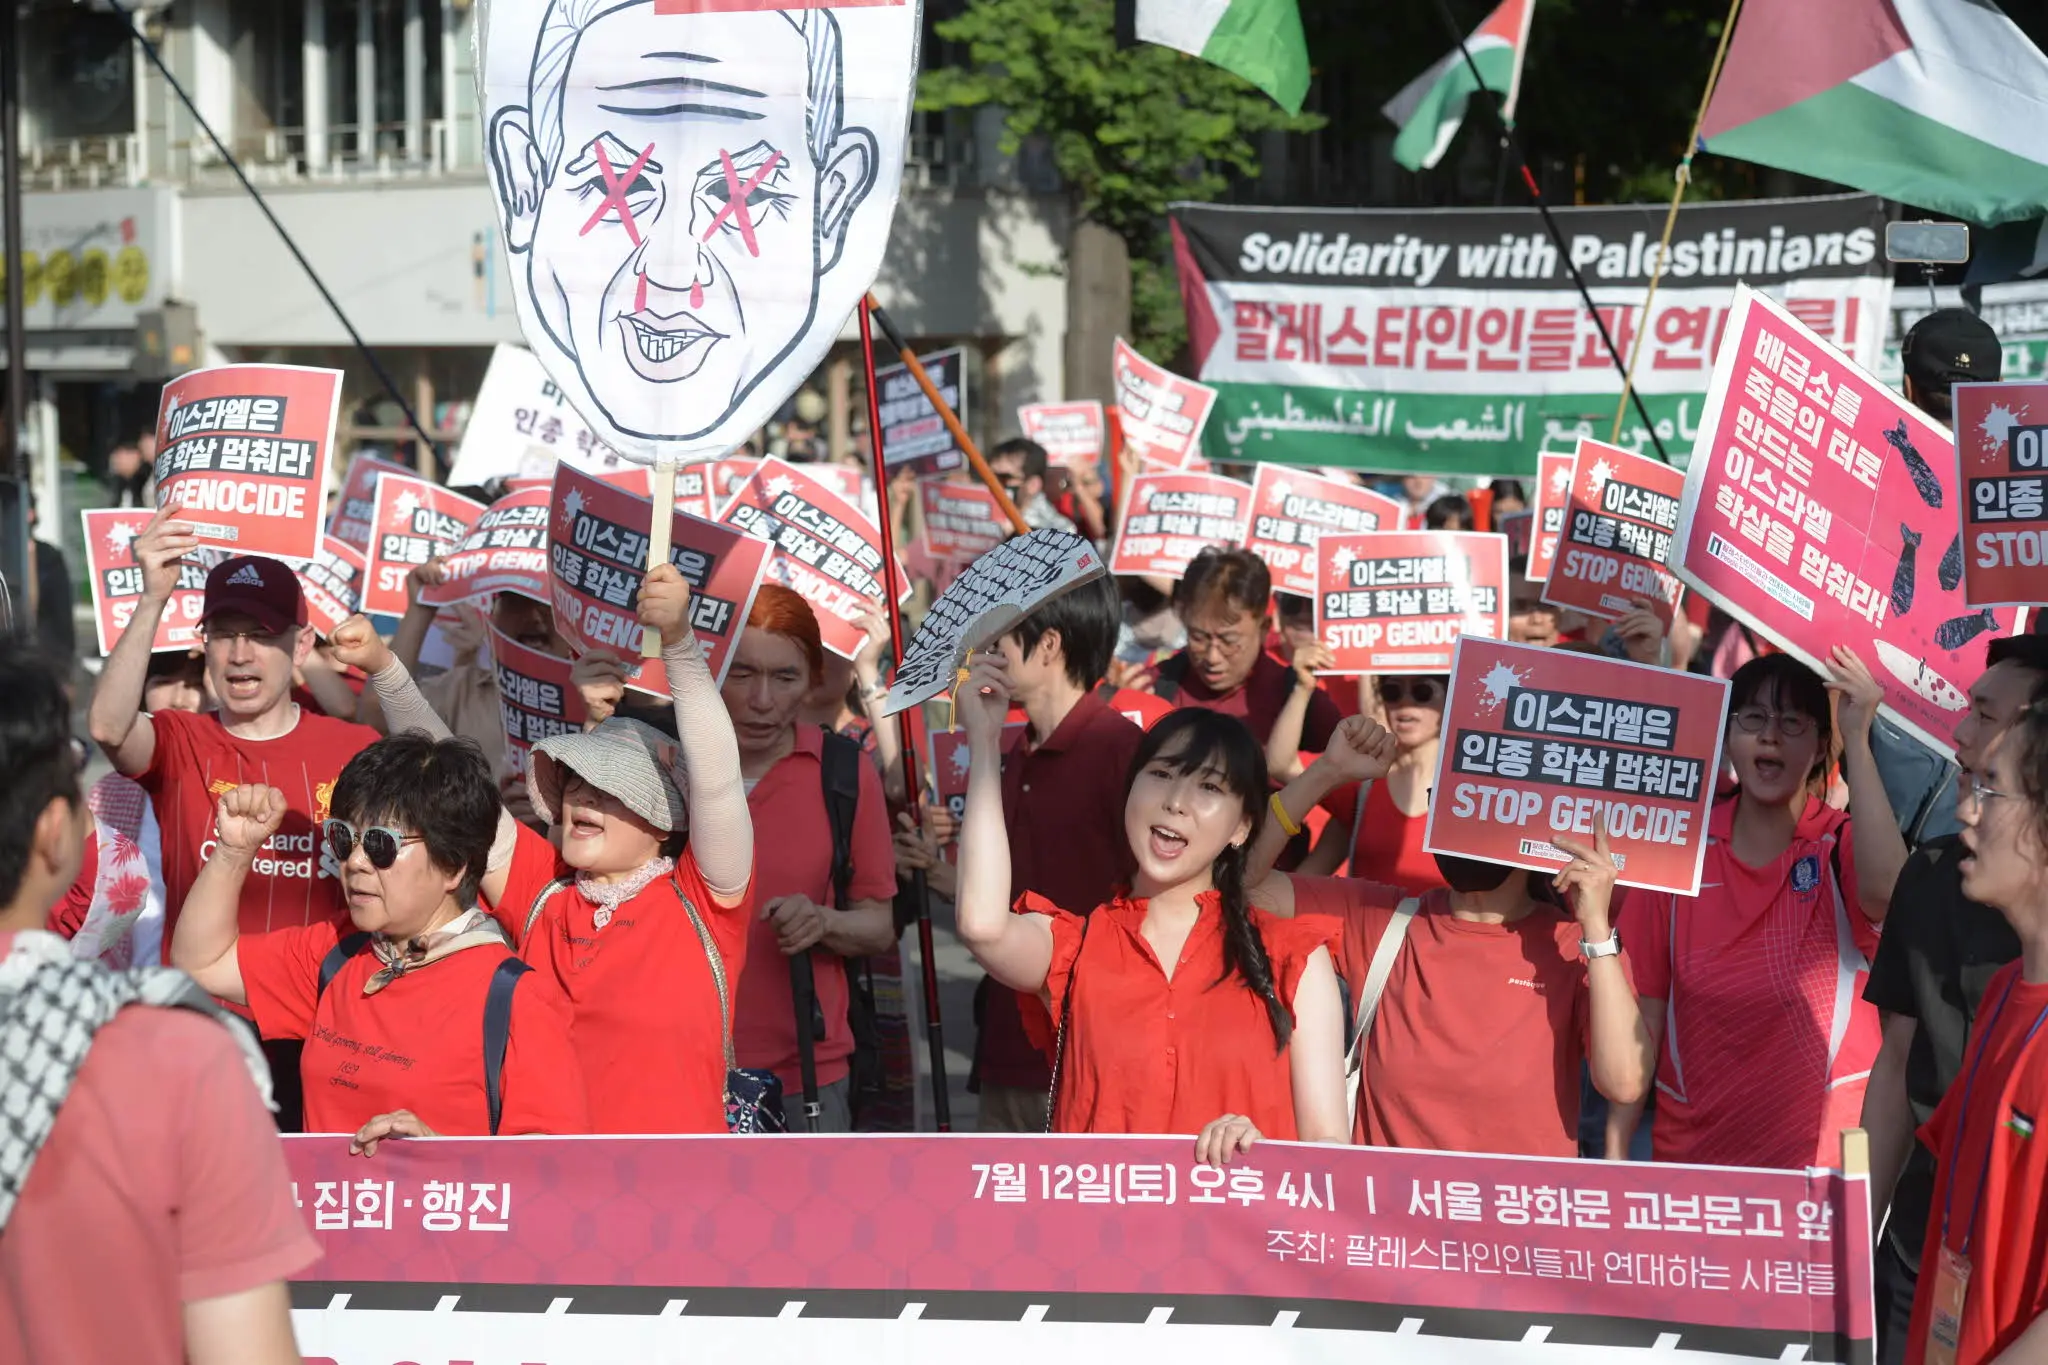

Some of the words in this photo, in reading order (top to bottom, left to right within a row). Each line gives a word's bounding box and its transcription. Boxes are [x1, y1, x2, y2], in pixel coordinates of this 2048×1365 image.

[1239, 232, 1450, 287] Solidarity
[1457, 234, 1557, 279] with
[1566, 226, 1876, 279] Palestinians
[1752, 327, 1863, 430] 배급소를
[169, 398, 280, 440] 이스라엘은
[1733, 404, 1816, 488] 만드는
[1744, 366, 1826, 450] 죽음의
[1826, 428, 1885, 491] 터로
[173, 437, 218, 471] 학살
[219, 437, 312, 477] 멈춰라
[169, 478, 306, 519] GENOCIDE
[1723, 446, 1833, 545] 이스라엘
[1975, 478, 2044, 521] 인종
[1573, 512, 1617, 549] 인종
[1617, 520, 1654, 558] 학살
[1713, 482, 1796, 566] 학살을
[1797, 543, 1889, 630] 멈춰라!
[552, 543, 585, 586] 인종
[584, 560, 640, 608] 학살
[1562, 549, 1619, 585] STOP
[1326, 590, 1371, 619] 인종
[1375, 588, 1423, 616] 학살
[1326, 622, 1383, 651] STOP
[1512, 691, 1672, 748] 이스라엘은
[1461, 734, 1533, 779] 인종
[1541, 741, 1610, 788] 학살
[1613, 751, 1699, 799] 멈춰라
[1451, 782, 1543, 827] STOP
[1548, 795, 1691, 847] GENOCIDE
[971, 1162, 1027, 1203] 7월
[1039, 1163, 1177, 1205] 12일(토)
[1189, 1166, 1265, 1206] 오후
[1277, 1171, 1336, 1212] 4시
[1408, 1178, 1482, 1223] 서울
[1494, 1182, 1611, 1229] 광화문
[1623, 1190, 1784, 1238] 교보문고
[1797, 1198, 1833, 1242] 앞
[1267, 1229, 1335, 1264] 주최:
[1346, 1233, 1595, 1283] 팔레스타인인들과
[1604, 1250, 1731, 1291] 연대하는
[1741, 1260, 1837, 1297] 사람들
